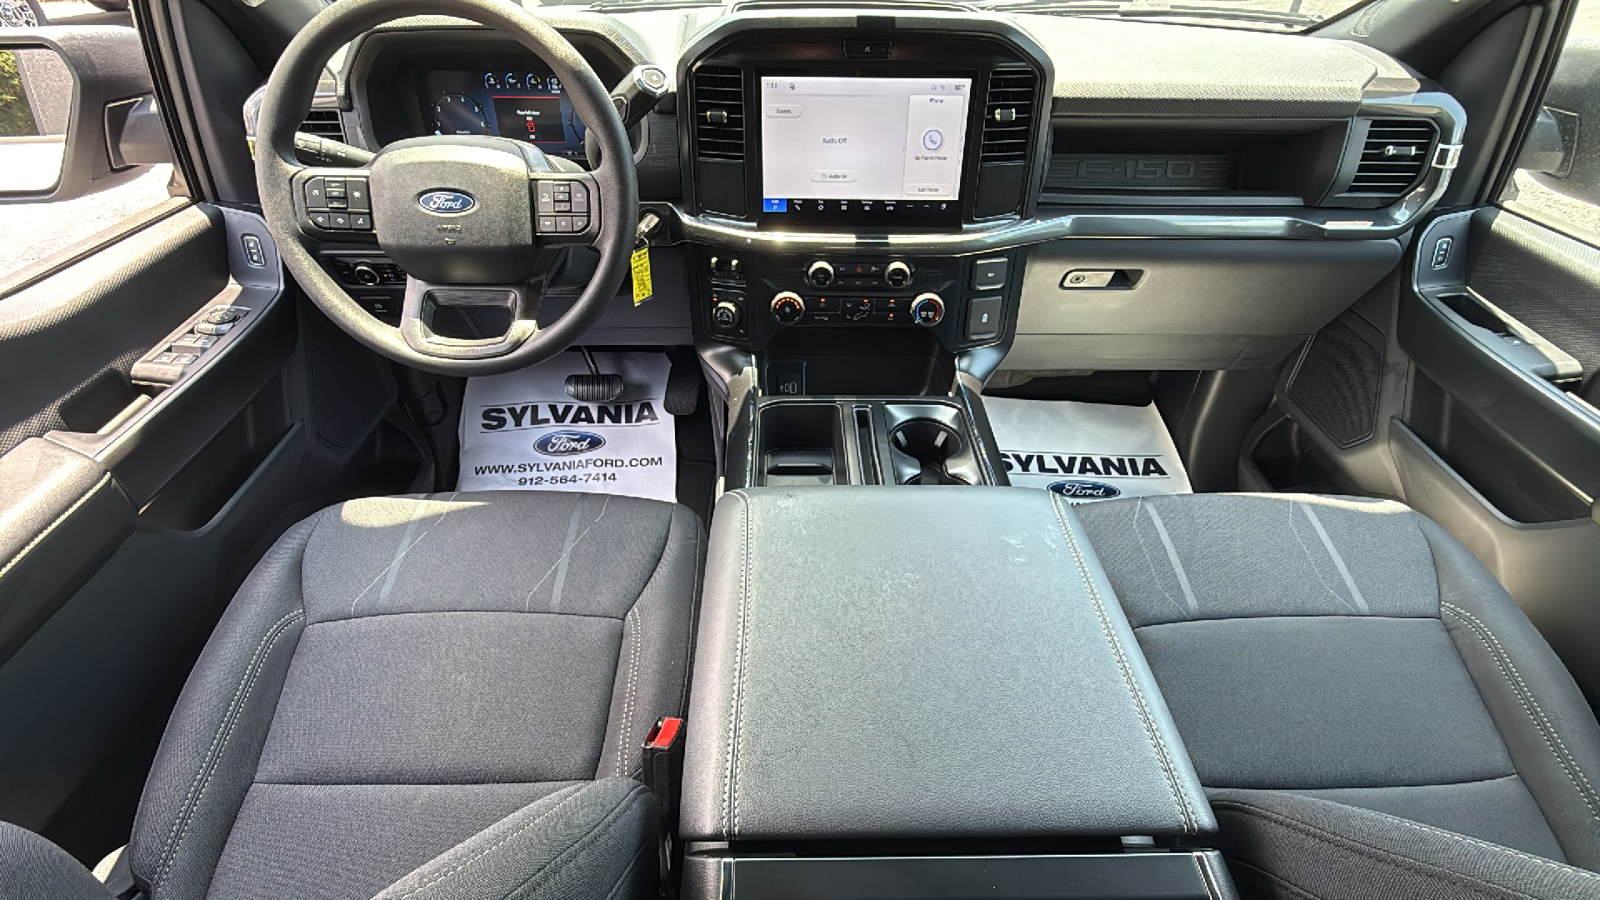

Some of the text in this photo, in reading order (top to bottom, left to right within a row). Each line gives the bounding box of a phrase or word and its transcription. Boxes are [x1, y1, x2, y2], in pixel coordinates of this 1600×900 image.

[1076, 159, 1196, 179] F-150
[429, 195, 463, 209] Ford
[481, 401, 659, 430] SYLVANIA
[547, 434, 590, 452] Ford
[474, 457, 663, 476] WWW.SYLVANIAFORD.COM
[518, 472, 617, 486] 912-564-7414
[1062, 483, 1106, 497] Ford
